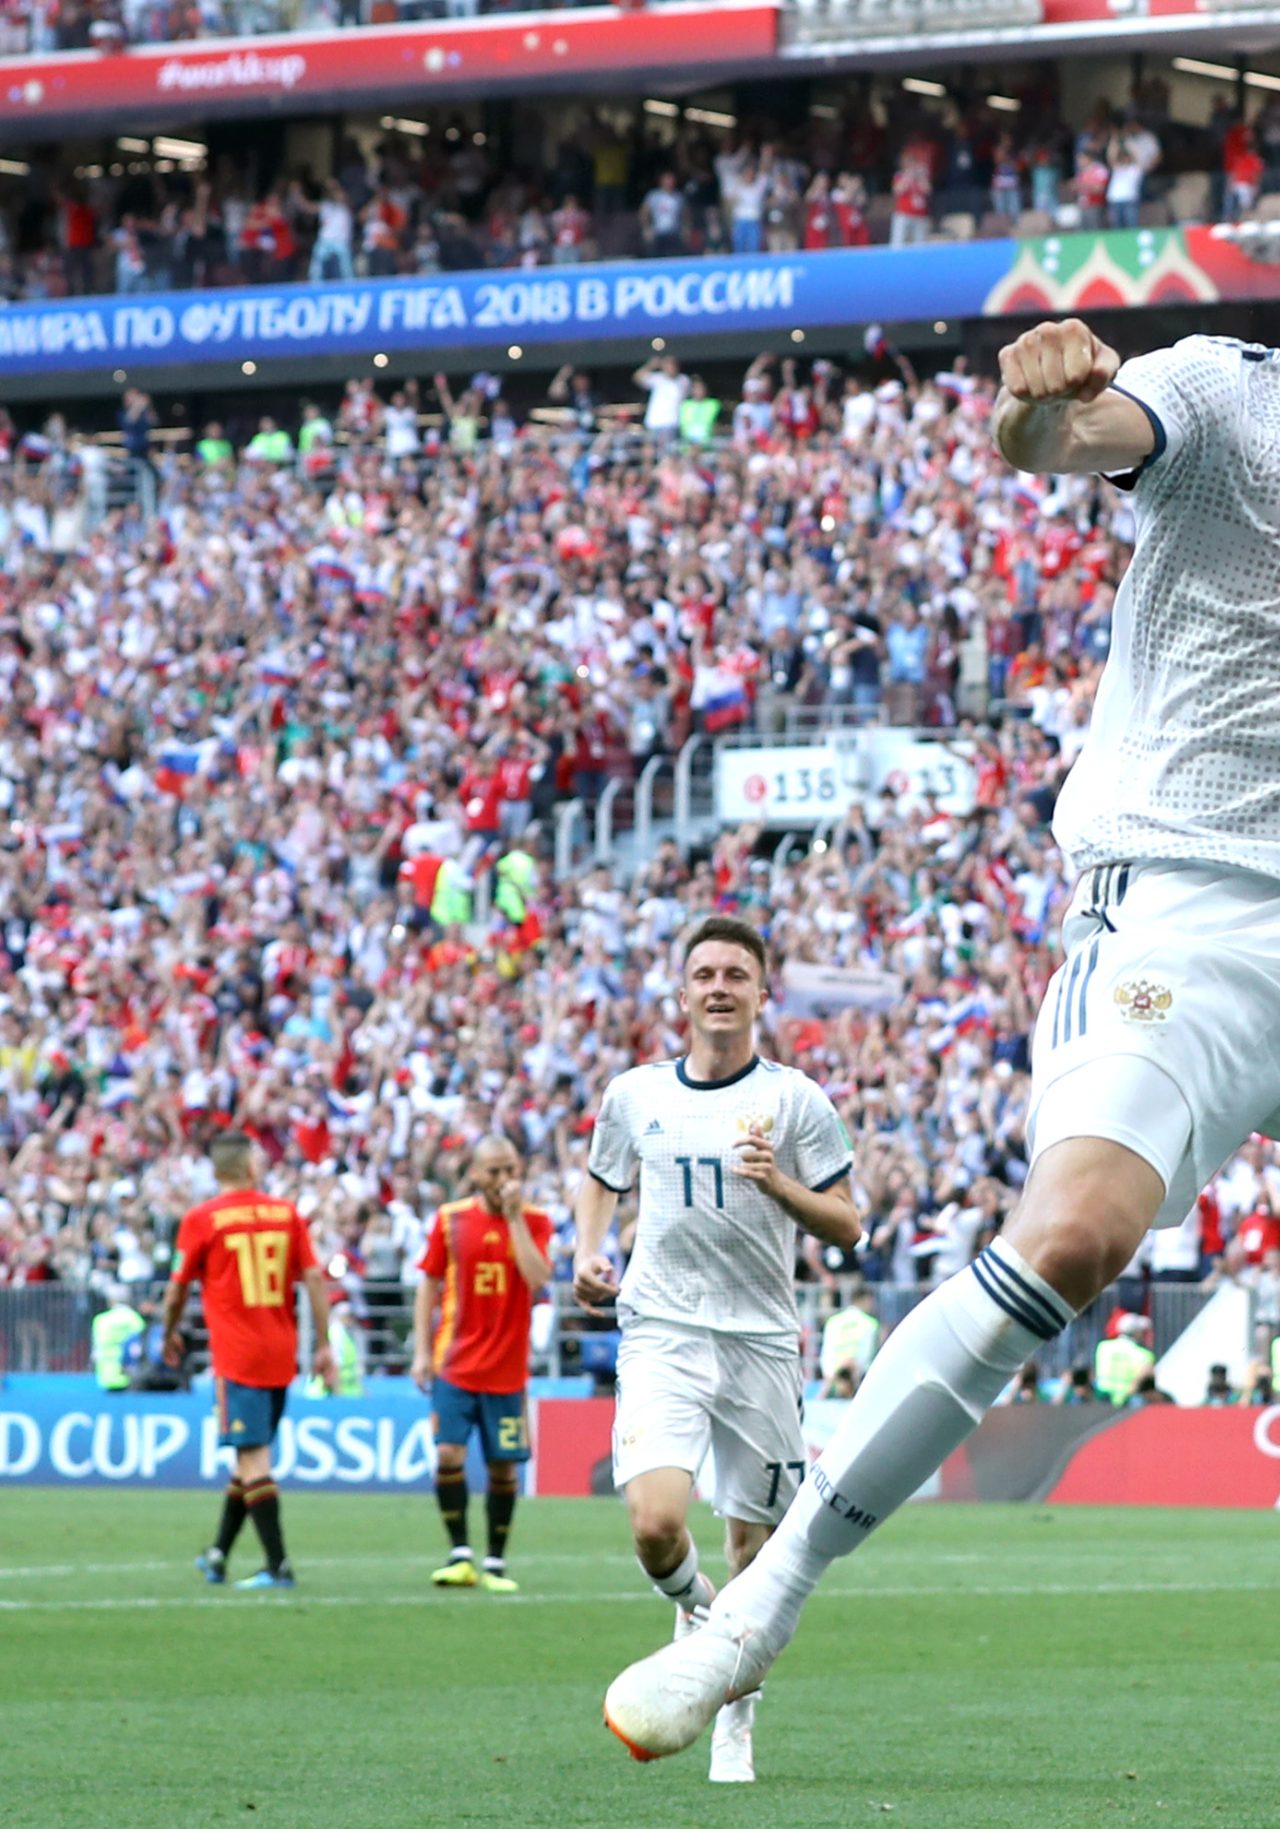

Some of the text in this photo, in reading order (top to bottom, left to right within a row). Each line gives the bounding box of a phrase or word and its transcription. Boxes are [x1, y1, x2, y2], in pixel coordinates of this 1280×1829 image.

[113, 304, 175, 348] ПО
[180, 291, 373, 344] ФУТБОЛУ
[378, 286, 467, 331] FIFA
[474, 278, 571, 327] 2018
[577, 277, 609, 320] В
[614, 265, 796, 318] РОССИИ
[675, 1156, 724, 1209] 17
[224, 1230, 290, 1308] 18
[474, 1262, 506, 1296] 21
[49, 1411, 190, 1479] CUP
[766, 1461, 805, 1507] 17
